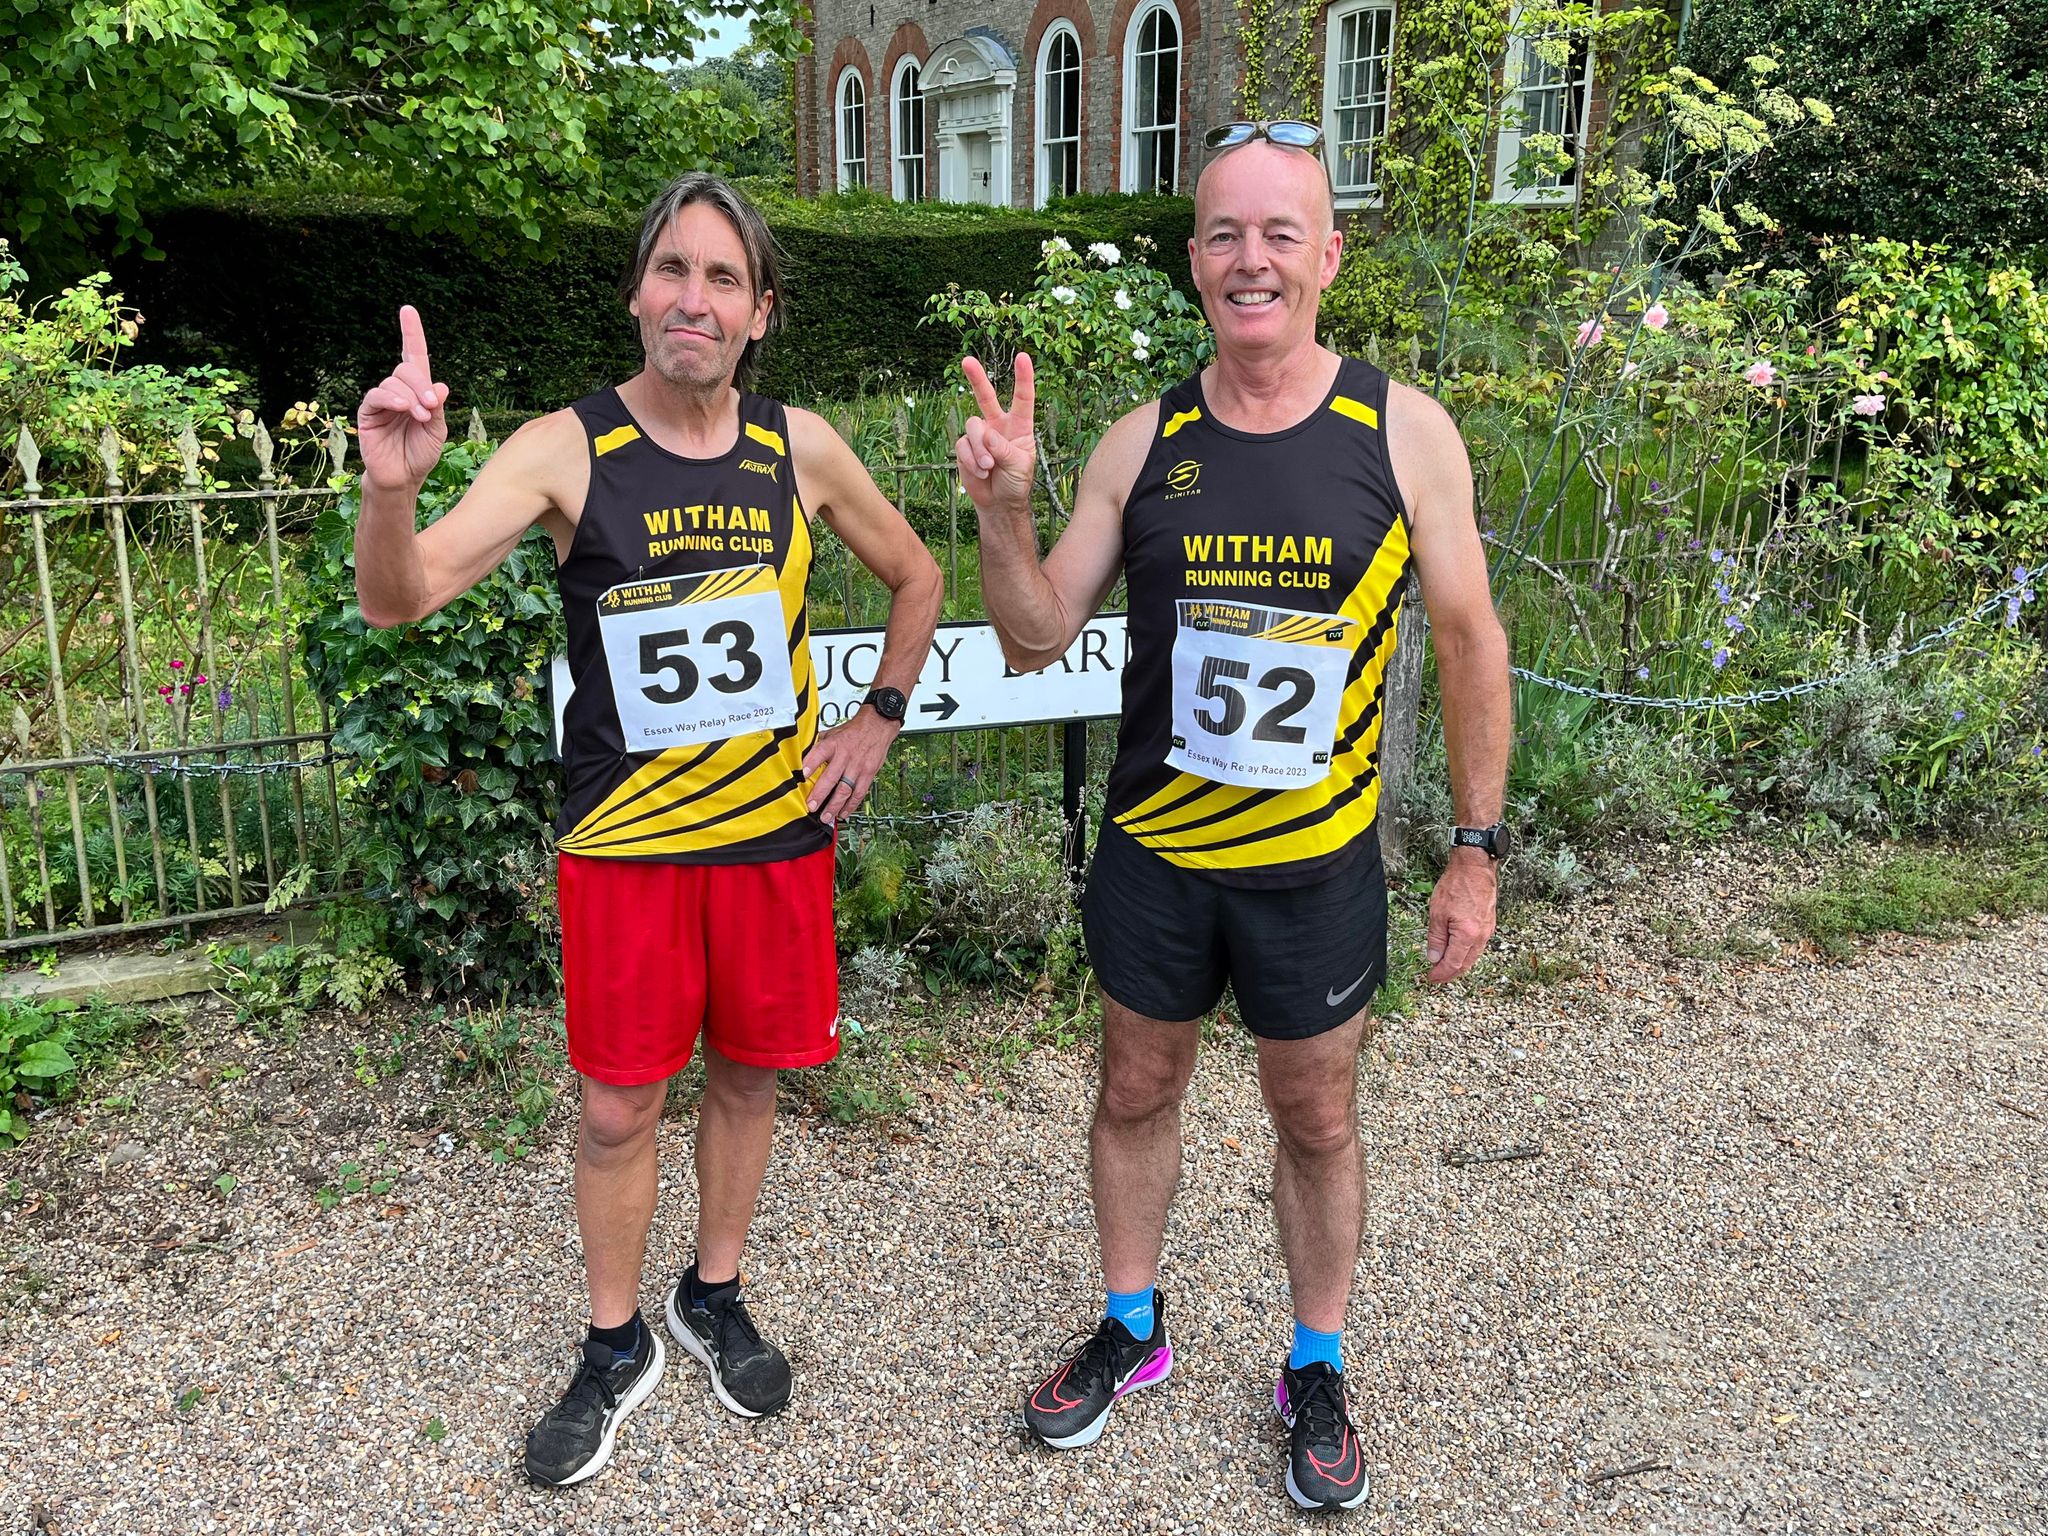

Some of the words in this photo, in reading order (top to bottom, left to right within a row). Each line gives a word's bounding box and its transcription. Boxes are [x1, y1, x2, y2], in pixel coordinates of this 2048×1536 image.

[643, 504, 771, 536] WITHAM
[648, 535, 724, 558] RUNNING
[729, 536, 775, 553] CLUB
[1183, 535, 1333, 566] WITHAM
[621, 582, 672, 599] WITHAM
[1185, 570, 1272, 587] RUNNING
[1278, 571, 1331, 590] CLUB
[624, 596, 654, 607] RUNNING
[655, 593, 673, 602] CLUB
[1205, 603, 1251, 621] WITHAM
[1231, 620, 1249, 629] CLUB
[638, 619, 763, 705] 53
[1192, 655, 1317, 745] 52
[643, 726, 673, 737] Essex
[675, 722, 697, 733] Way
[699, 717, 727, 730] Relay
[728, 712, 752, 723] Race
[753, 706, 775, 718] 2023
[1187, 749, 1210, 763] Essex
[1211, 755, 1228, 771] Way
[1230, 761, 1259, 775] Reay
[1261, 764, 1284, 775] Race
[1286, 766, 1307, 776] 2023
